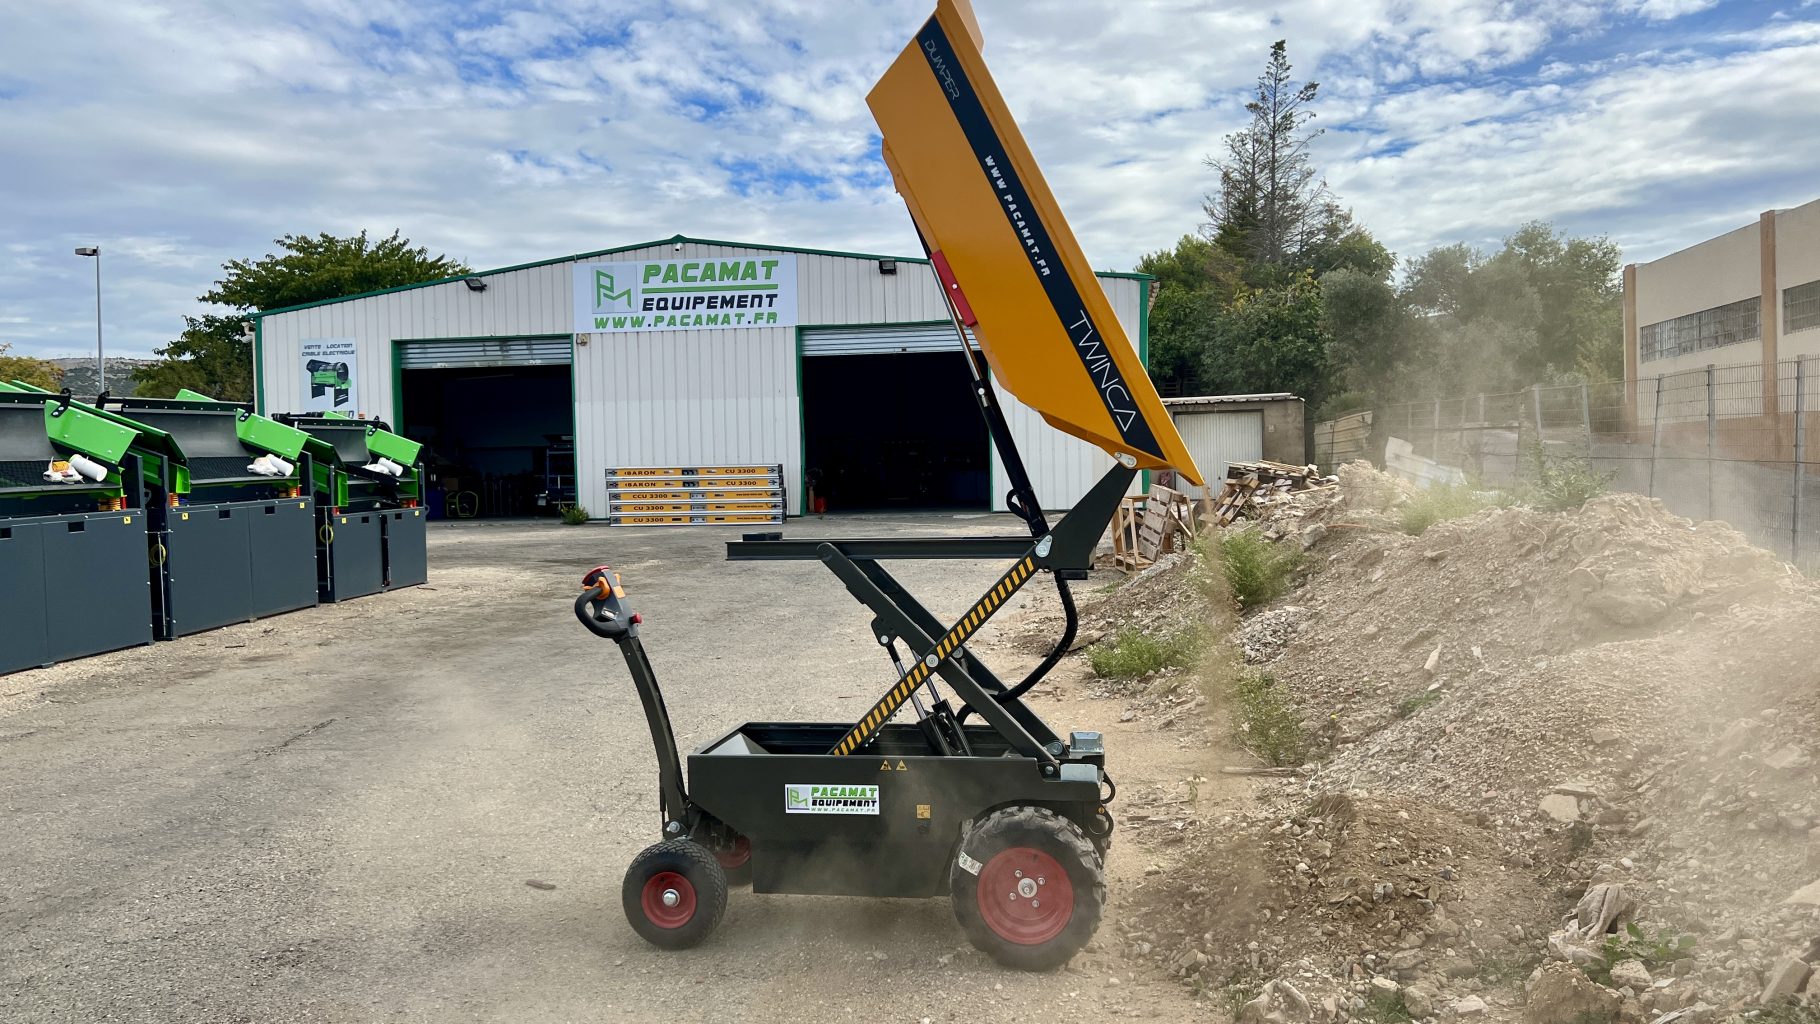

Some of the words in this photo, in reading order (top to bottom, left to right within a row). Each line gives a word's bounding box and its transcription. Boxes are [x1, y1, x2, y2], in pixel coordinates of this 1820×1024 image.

[924, 39, 960, 101] DUMPER
[641, 259, 779, 284] PACAMAT
[641, 293, 778, 312] EQUIPEMENT
[594, 311, 778, 330] WWW.PACAMAT.FR
[1069, 309, 1136, 432] TWINCA
[811, 786, 878, 797] PACAMAT
[811, 799, 877, 807] EQUIPEMENT
